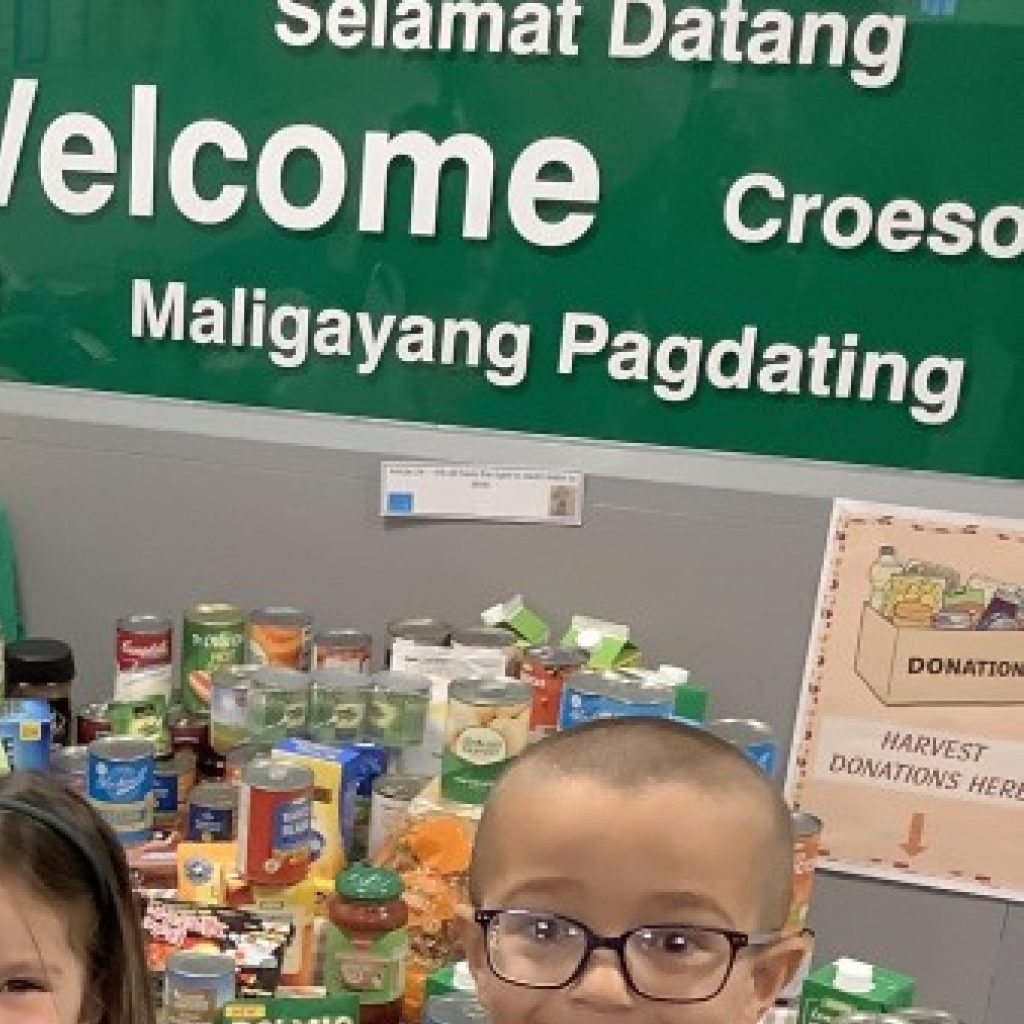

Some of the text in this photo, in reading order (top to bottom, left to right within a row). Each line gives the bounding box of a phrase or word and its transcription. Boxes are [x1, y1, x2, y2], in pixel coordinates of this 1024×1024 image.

[275, 0, 907, 88] Selamat Datang
[723, 172, 1024, 260] Croeso
[131, 278, 966, 426] Maligayang Pagdating
[829, 752, 964, 790] DONATIONS
[880, 730, 991, 763] HARVEST
